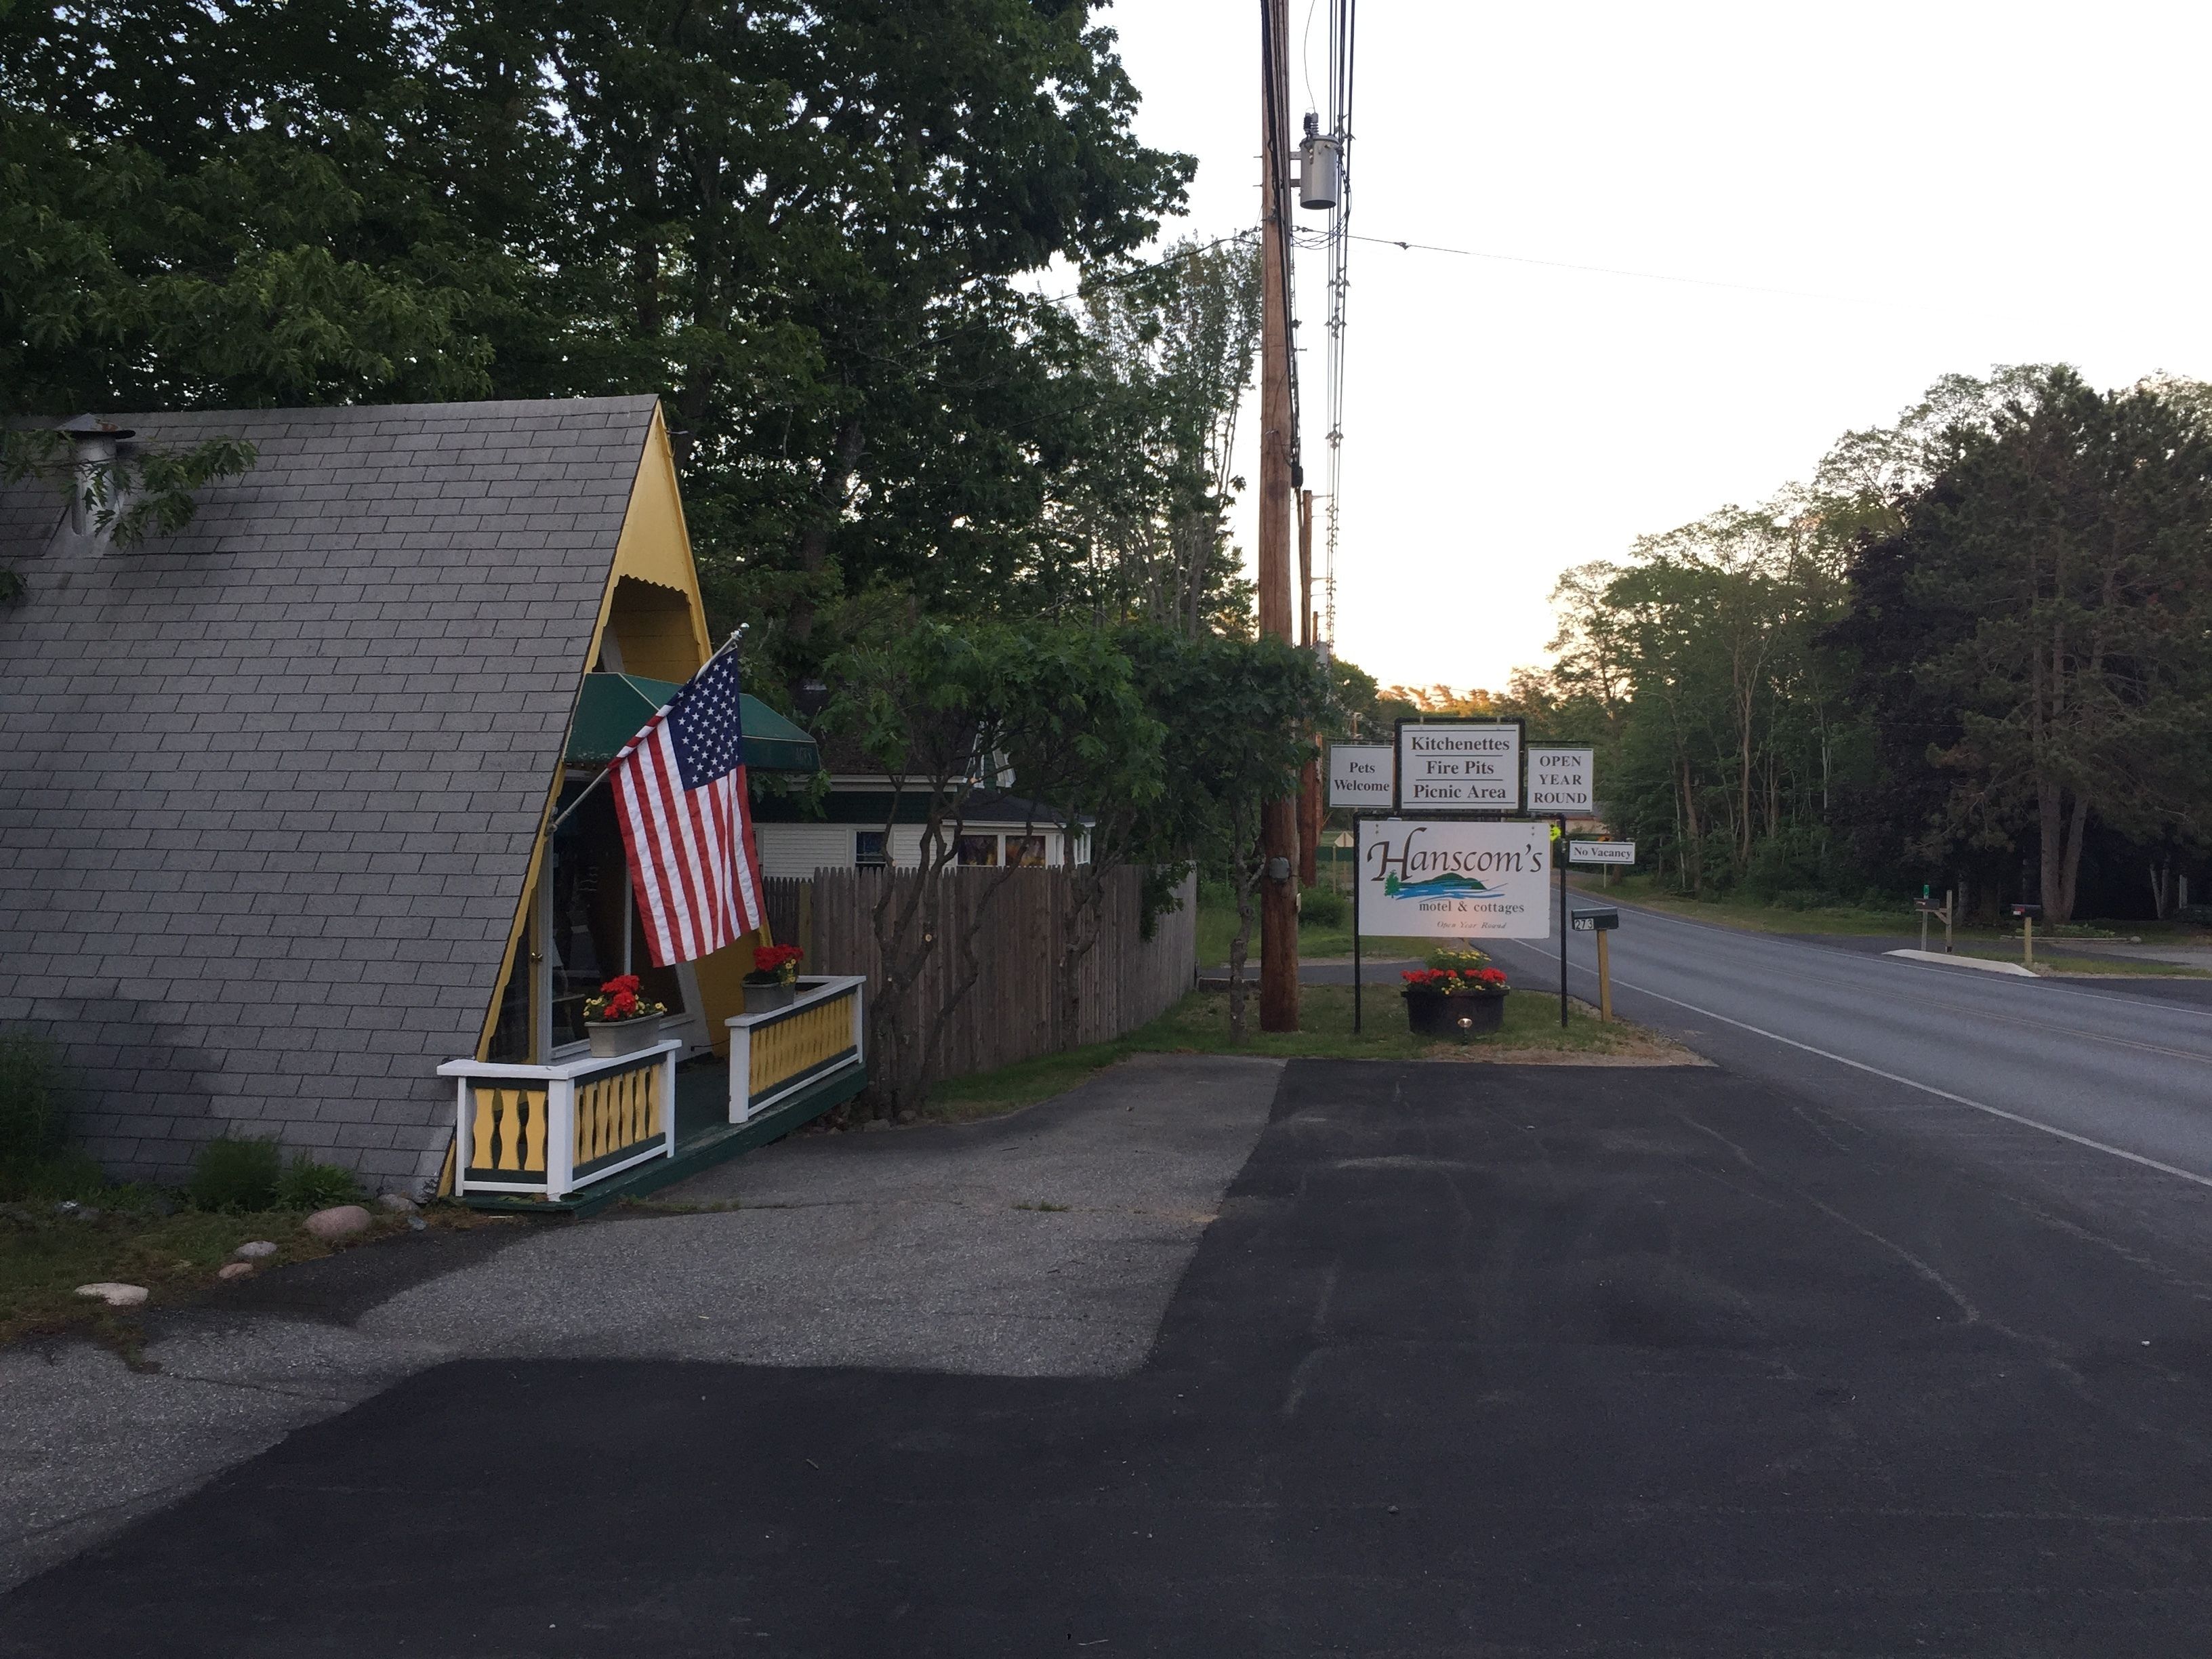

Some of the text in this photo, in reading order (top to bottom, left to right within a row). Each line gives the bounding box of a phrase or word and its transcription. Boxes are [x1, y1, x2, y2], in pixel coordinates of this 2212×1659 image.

[1411, 736, 1510, 751] Kitchenettes
[1349, 761, 1376, 774] Pets
[1426, 760, 1494, 775] Fire Pits
[1539, 756, 1582, 767] OPEN
[1334, 779, 1390, 792] Welcome
[1538, 774, 1582, 785] YEAR
[1413, 784, 1507, 799] Picnic Area
[1534, 792, 1587, 804] ROUND
[1367, 827, 1542, 881] Hanscom's
[1574, 847, 1632, 859] No Vacancy
[1419, 900, 1524, 915] motel & cottages
[1437, 921, 1456, 929] Open
[1481, 921, 1507, 929] Round
[1575, 919, 1593, 930] 273
